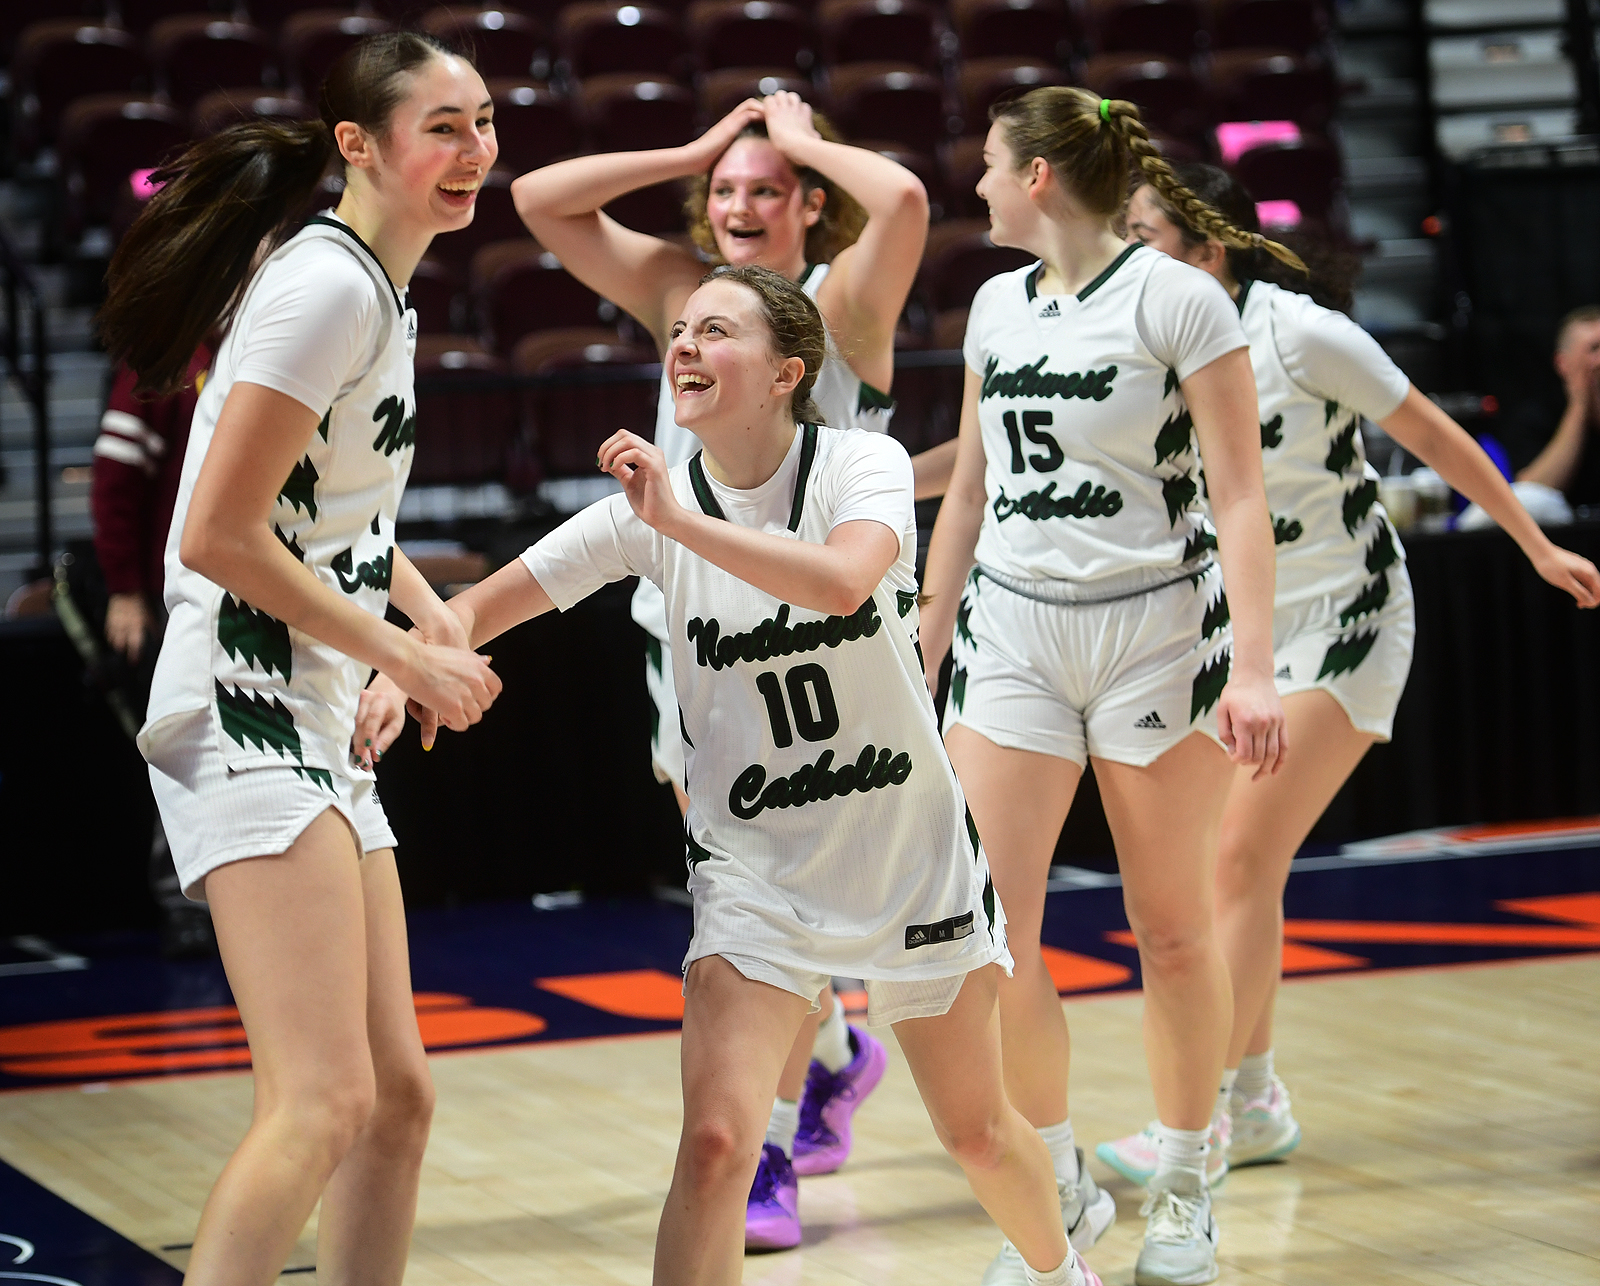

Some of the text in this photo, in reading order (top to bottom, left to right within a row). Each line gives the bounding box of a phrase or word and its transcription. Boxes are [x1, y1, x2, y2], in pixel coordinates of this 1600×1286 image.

[981, 355, 1118, 401] Northwest
[1003, 410, 1064, 474] 15
[687, 595, 882, 671] Northwest
[755, 663, 840, 748] 10
[728, 744, 913, 820] Catholic
[938, 929, 945, 937] M
